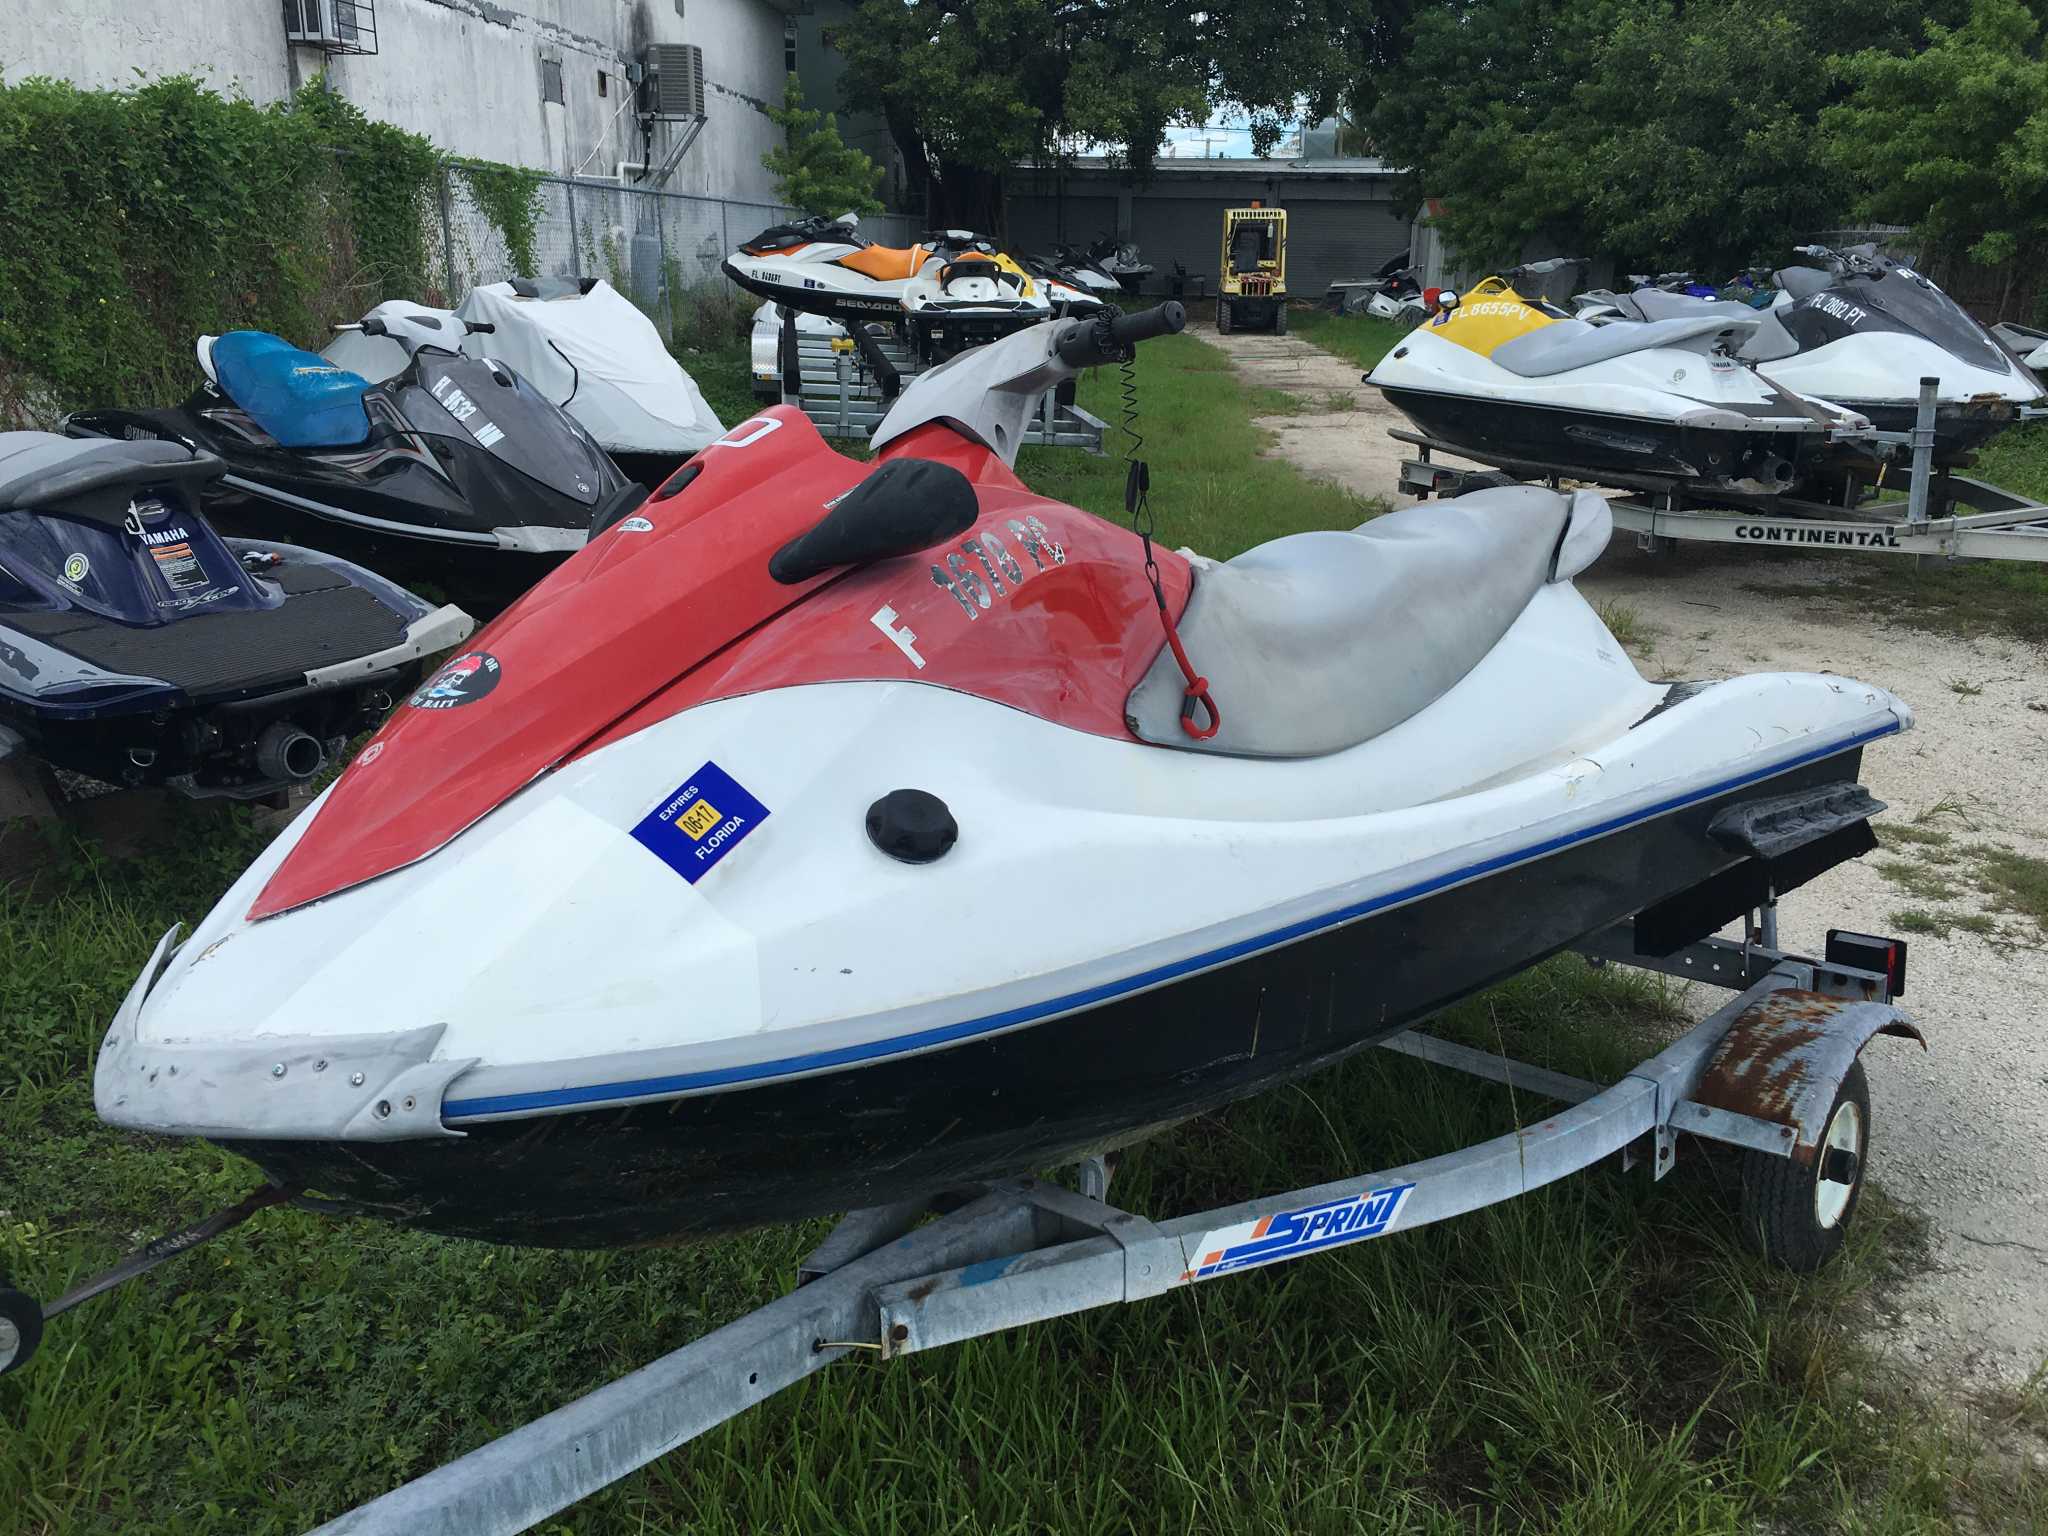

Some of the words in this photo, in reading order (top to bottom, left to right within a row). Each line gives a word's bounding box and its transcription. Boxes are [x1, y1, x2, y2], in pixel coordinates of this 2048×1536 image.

[1810, 293, 1825, 307] FL
[1822, 297, 1849, 318] 2802
[1844, 306, 1867, 326] PT
[139, 527, 189, 546] YAMAHA
[1735, 525, 1900, 547] CONTINENTAL
[659, 785, 699, 821] EXPIRES
[683, 805, 714, 834] 06-17
[695, 815, 745, 860] FLORIDA
[1262, 1183, 1416, 1243] SPRINT
